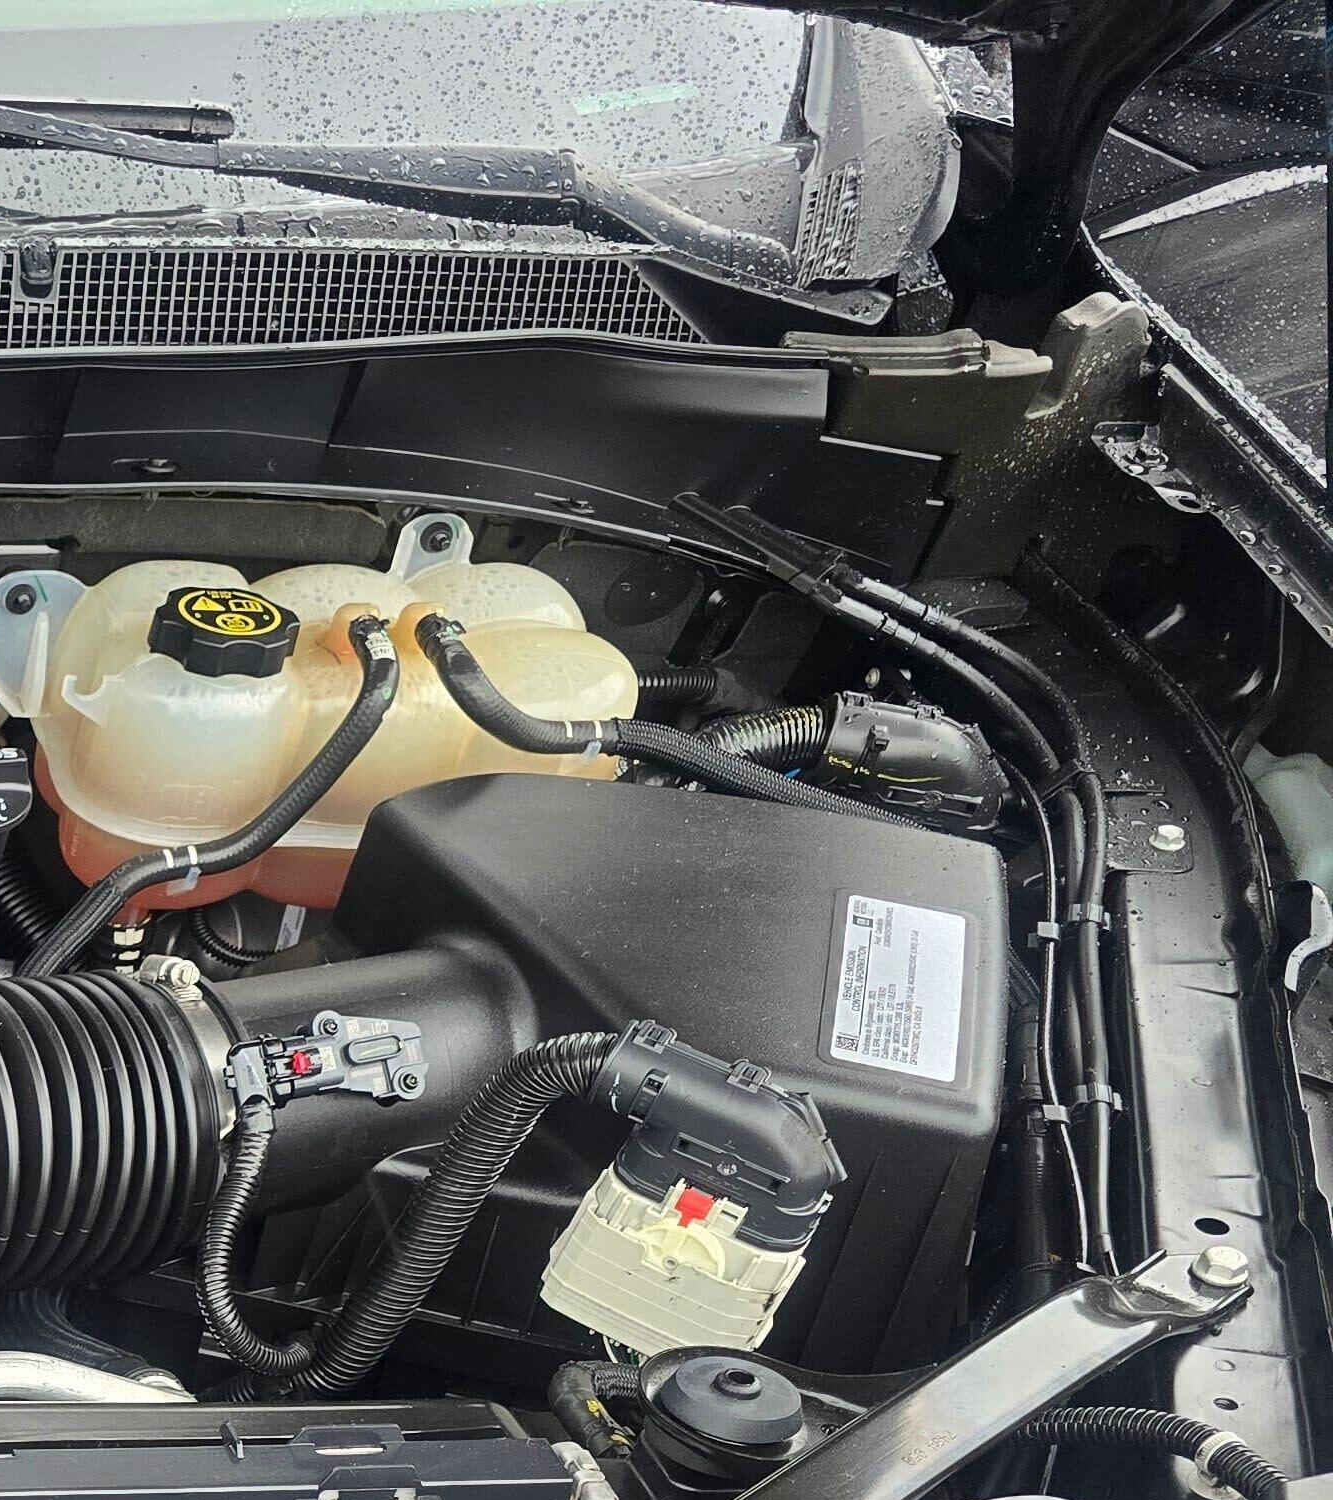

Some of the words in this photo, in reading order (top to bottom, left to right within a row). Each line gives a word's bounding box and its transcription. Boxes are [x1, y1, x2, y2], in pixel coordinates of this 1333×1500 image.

[854, 944, 867, 983] INFORMATION
[842, 976, 853, 1001] VEHICLE
[851, 983, 863, 1011] CONTROL
